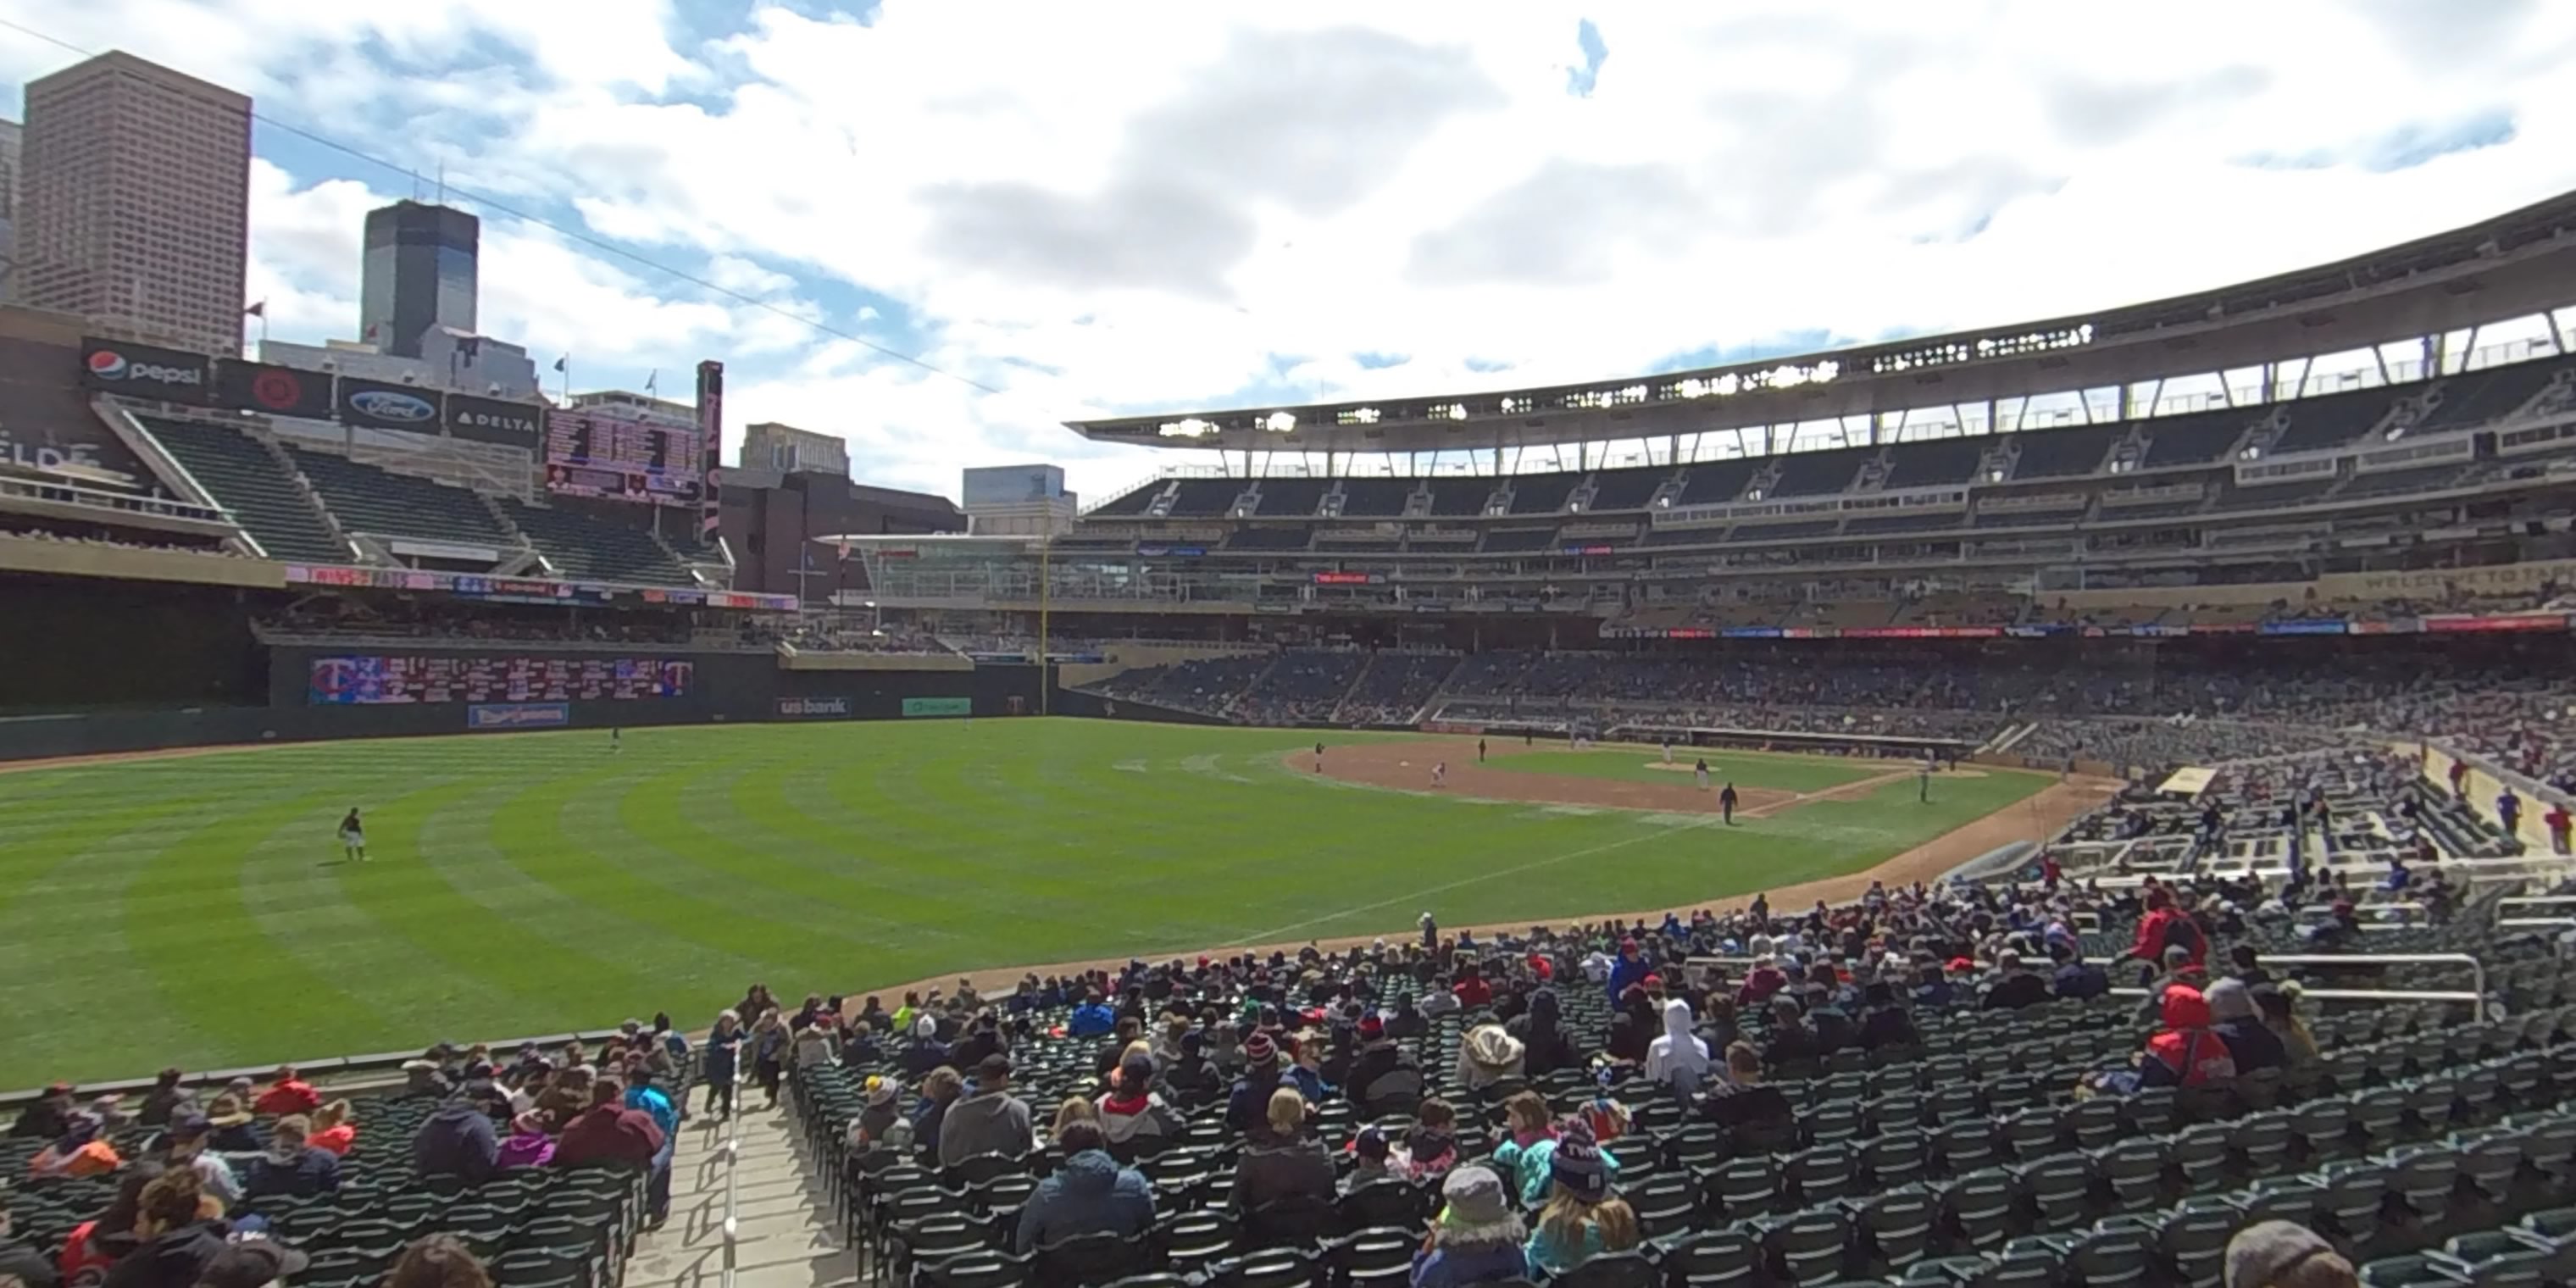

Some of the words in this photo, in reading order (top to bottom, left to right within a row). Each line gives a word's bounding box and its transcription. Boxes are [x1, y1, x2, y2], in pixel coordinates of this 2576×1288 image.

[130, 363, 201, 385] pepsi
[366, 400, 421, 419] Ford
[476, 414, 535, 432] DELTA
[2487, 569, 2517, 583] TO
